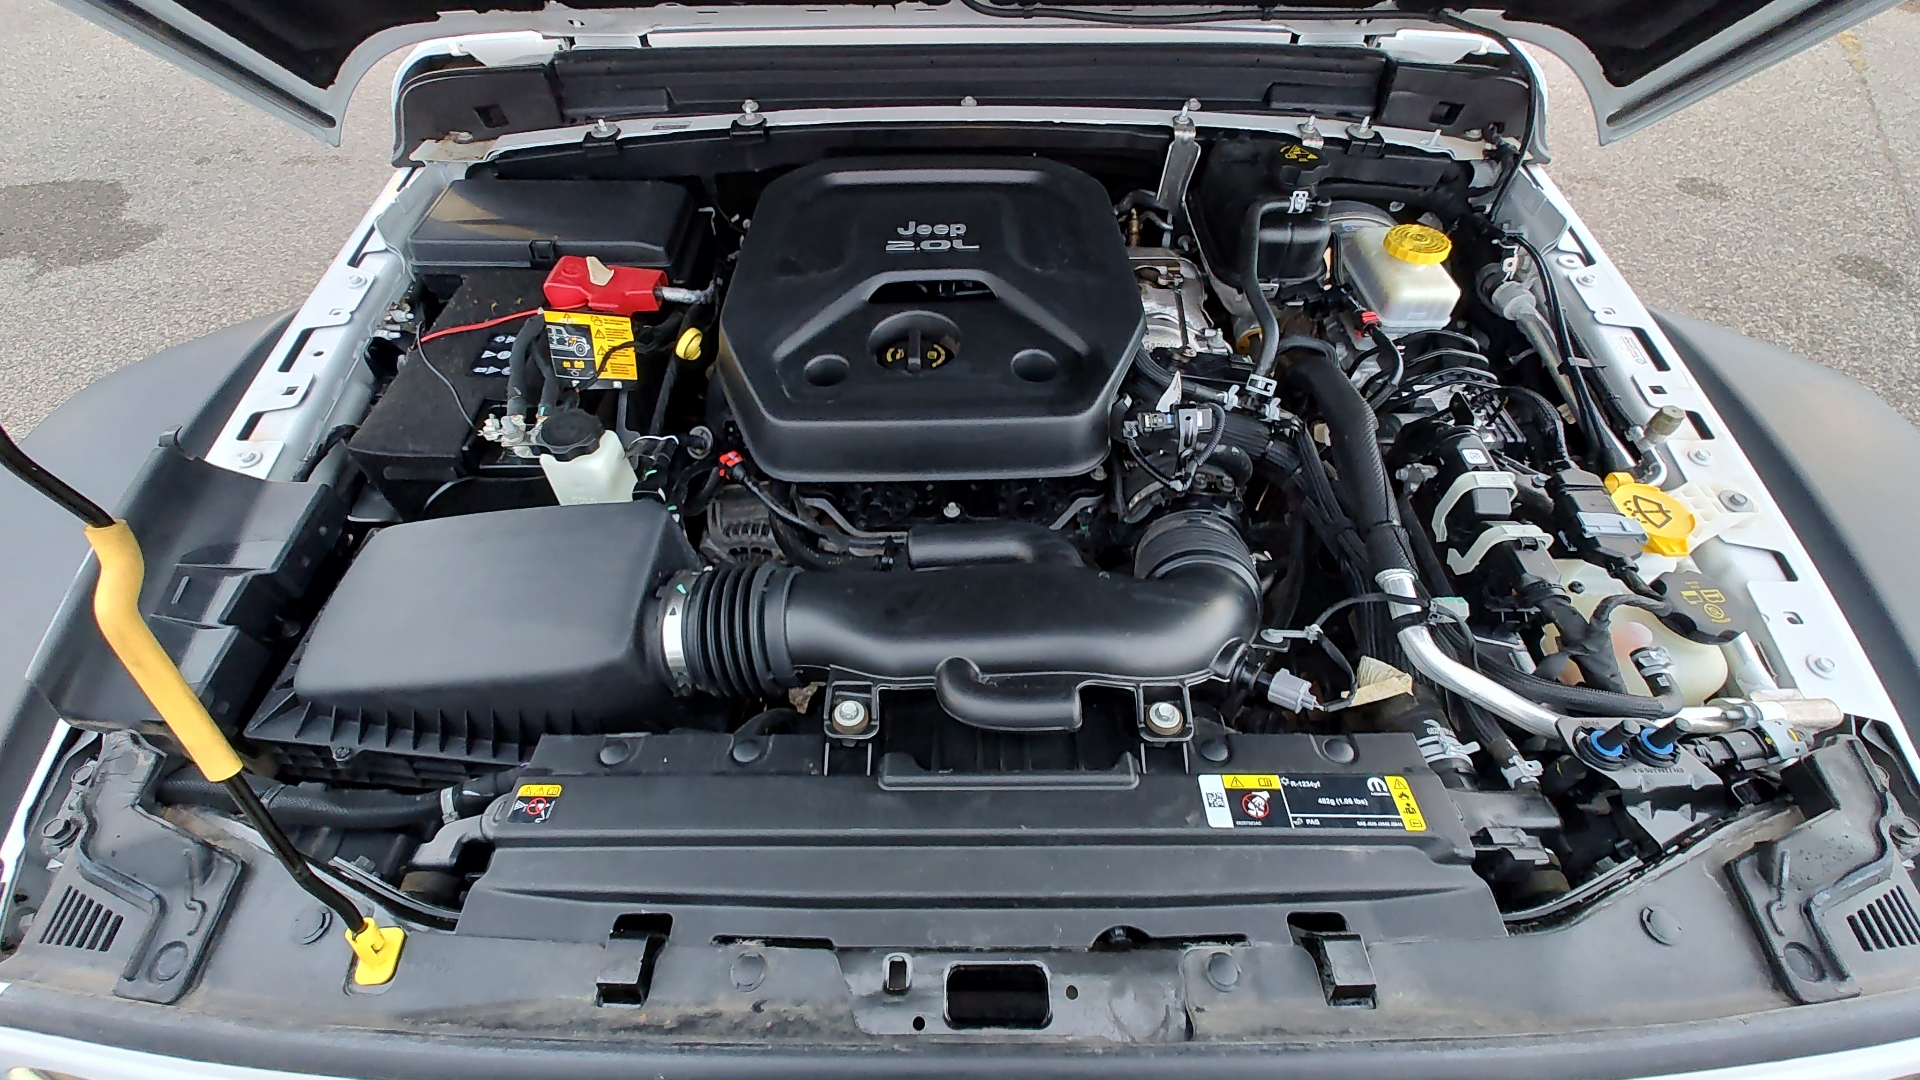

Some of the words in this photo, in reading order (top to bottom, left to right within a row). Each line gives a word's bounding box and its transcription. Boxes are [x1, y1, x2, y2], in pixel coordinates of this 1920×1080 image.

[897, 221, 967, 237] Jeep
[885, 239, 980, 251] 2.0L
[1305, 818, 1321, 826] PAG
